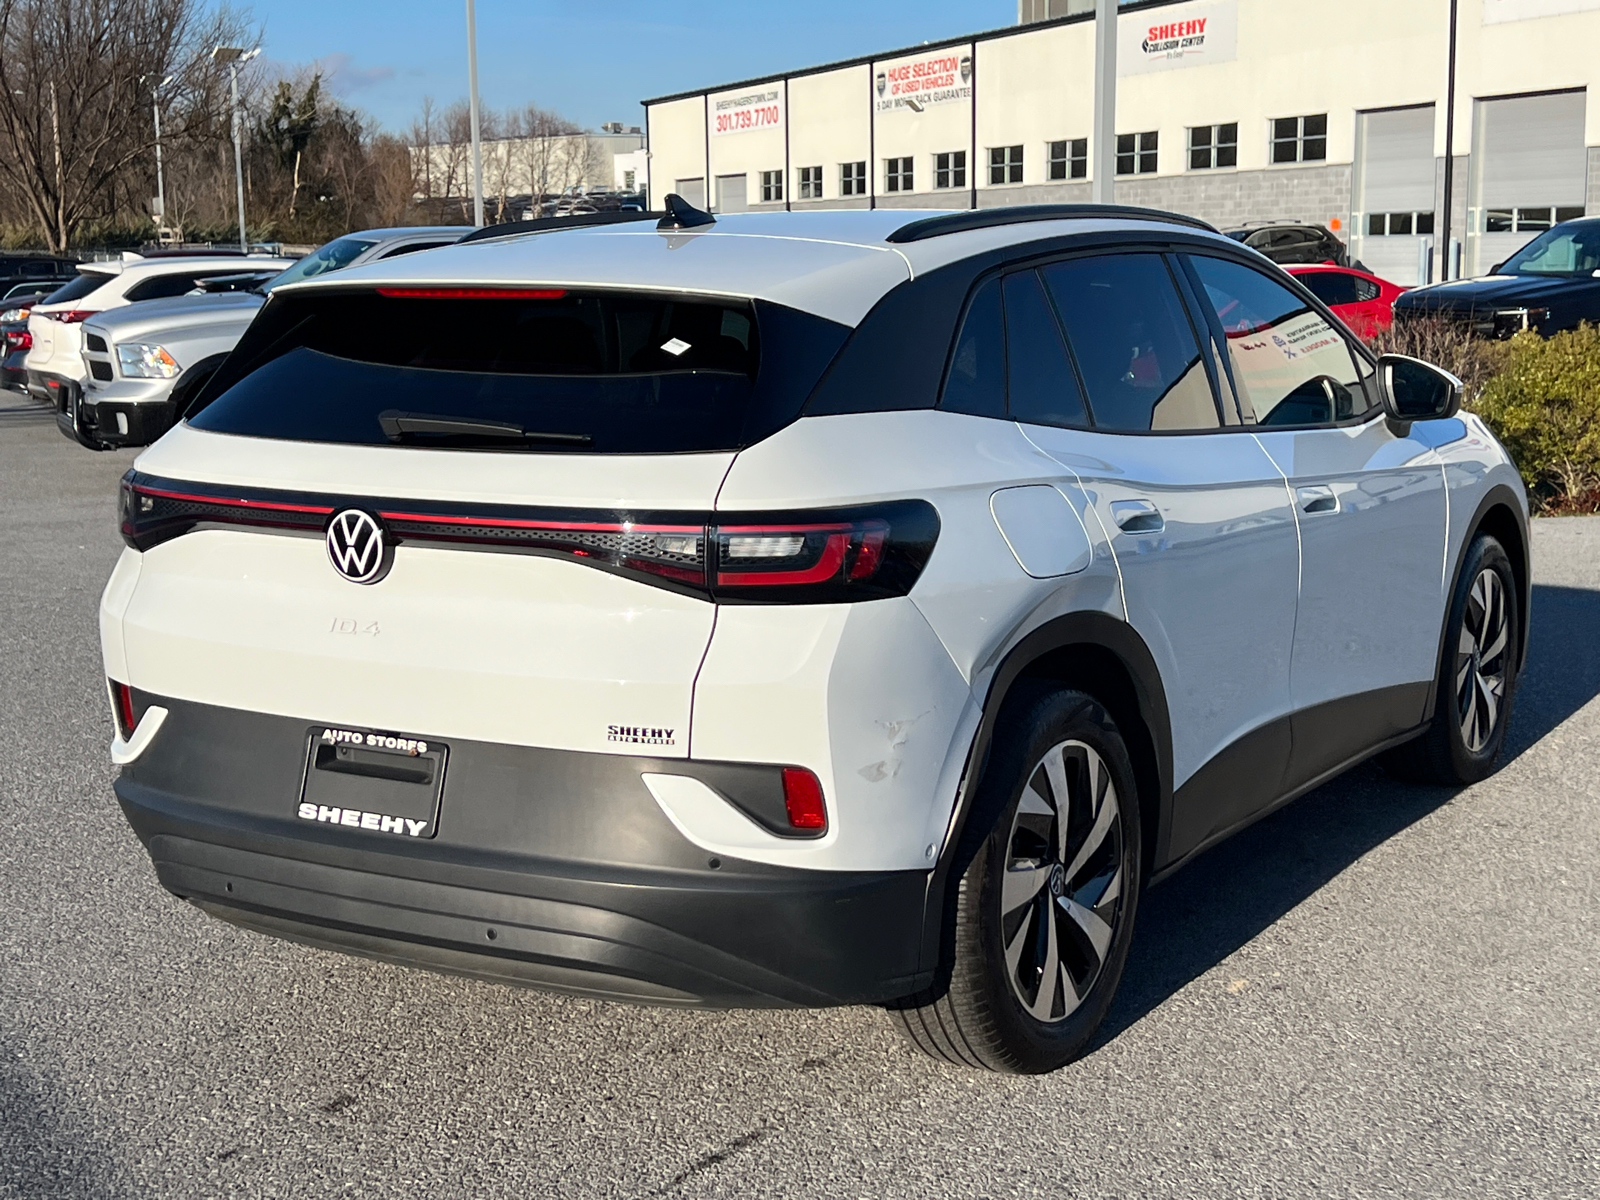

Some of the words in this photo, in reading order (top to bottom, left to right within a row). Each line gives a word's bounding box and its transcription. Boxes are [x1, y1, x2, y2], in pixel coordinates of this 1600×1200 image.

[1148, 17, 1207, 42] SHEEHY
[1149, 40, 1180, 53] COLLISION
[1181, 35, 1205, 48] CENTER
[888, 65, 911, 82] HUGE
[912, 56, 959, 78] SELECTION
[891, 83, 901, 95] OF
[902, 80, 920, 93] USED
[921, 73, 955, 90] VEHICLES
[882, 99, 893, 110] DAY
[933, 87, 971, 101] GUARANTEE
[716, 105, 779, 132] 301.739.7700
[322, 729, 363, 745] AUTO
[367, 734, 427, 753] STORES
[607, 725, 675, 739] SHEEHY
[298, 803, 428, 837] SHEEHY
